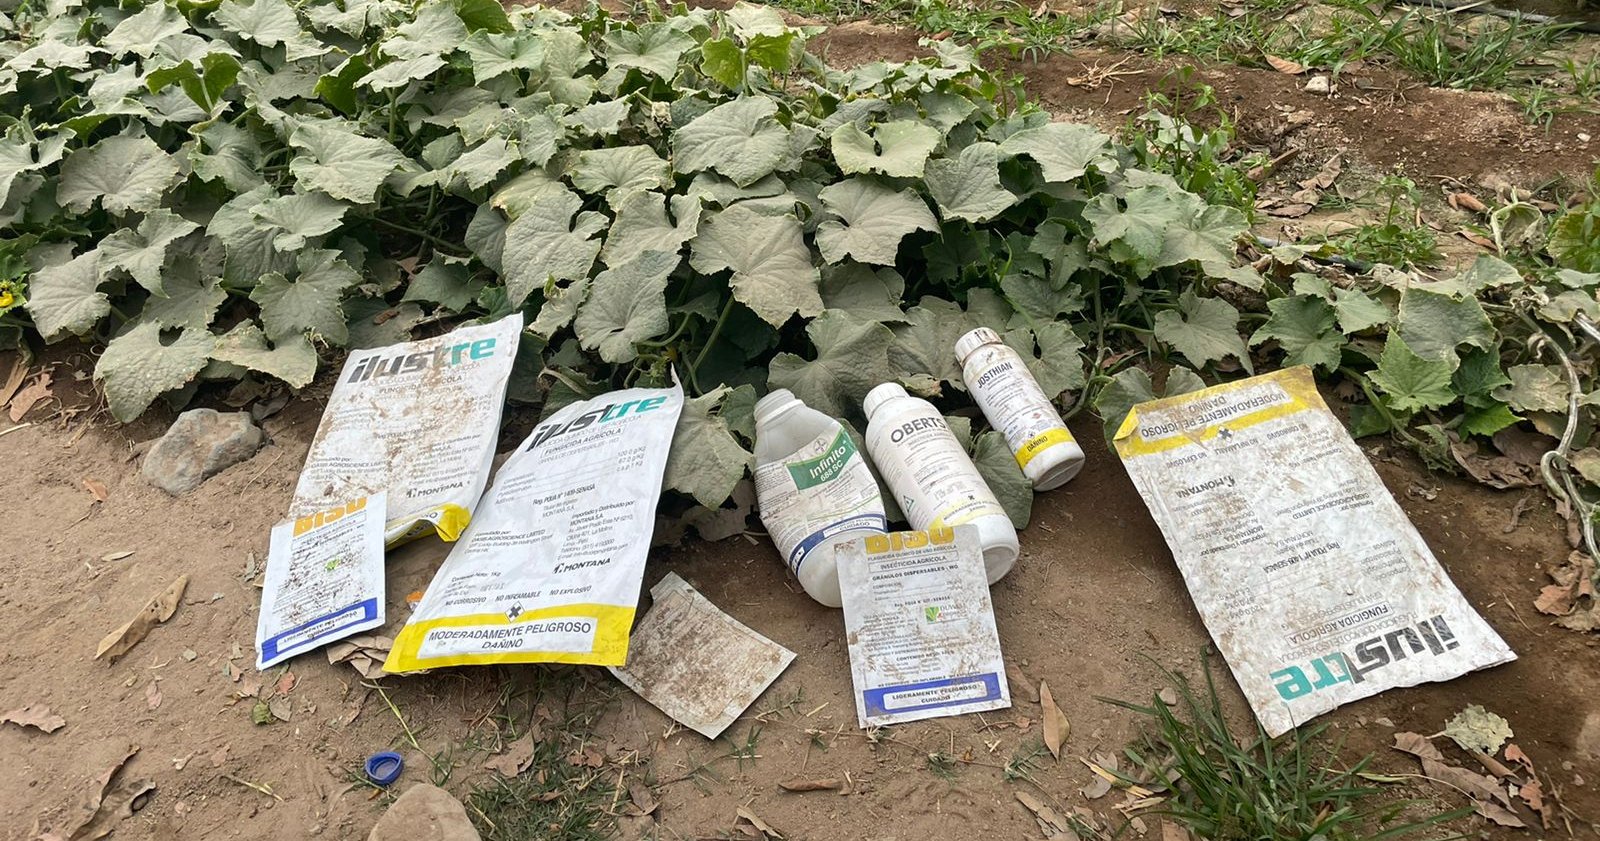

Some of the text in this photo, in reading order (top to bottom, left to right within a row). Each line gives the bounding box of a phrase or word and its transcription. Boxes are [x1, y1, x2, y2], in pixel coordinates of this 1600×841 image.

[347, 338, 496, 383] ilustre
[977, 362, 1013, 388] JOSTHIAN
[1141, 393, 1283, 436] MODERADAMENTE PELIGROSO
[809, 445, 846, 479] Infinito
[820, 460, 844, 483] 688 SC
[418, 482, 463, 498] MONTANA
[1176, 478, 1223, 497] MONTANA
[1292, 507, 1316, 519] LIMITED
[563, 558, 610, 571] MONTANA
[564, 585, 592, 596] EXPLOSIVO
[1338, 605, 1387, 626] FUNGICIDA
[429, 622, 591, 642] MODERADAMENTE PELIGROSO
[482, 638, 523, 650] DAÑINO
[1269, 614, 1461, 701] ilustre
[892, 690, 937, 699] LIGERAMENTE
